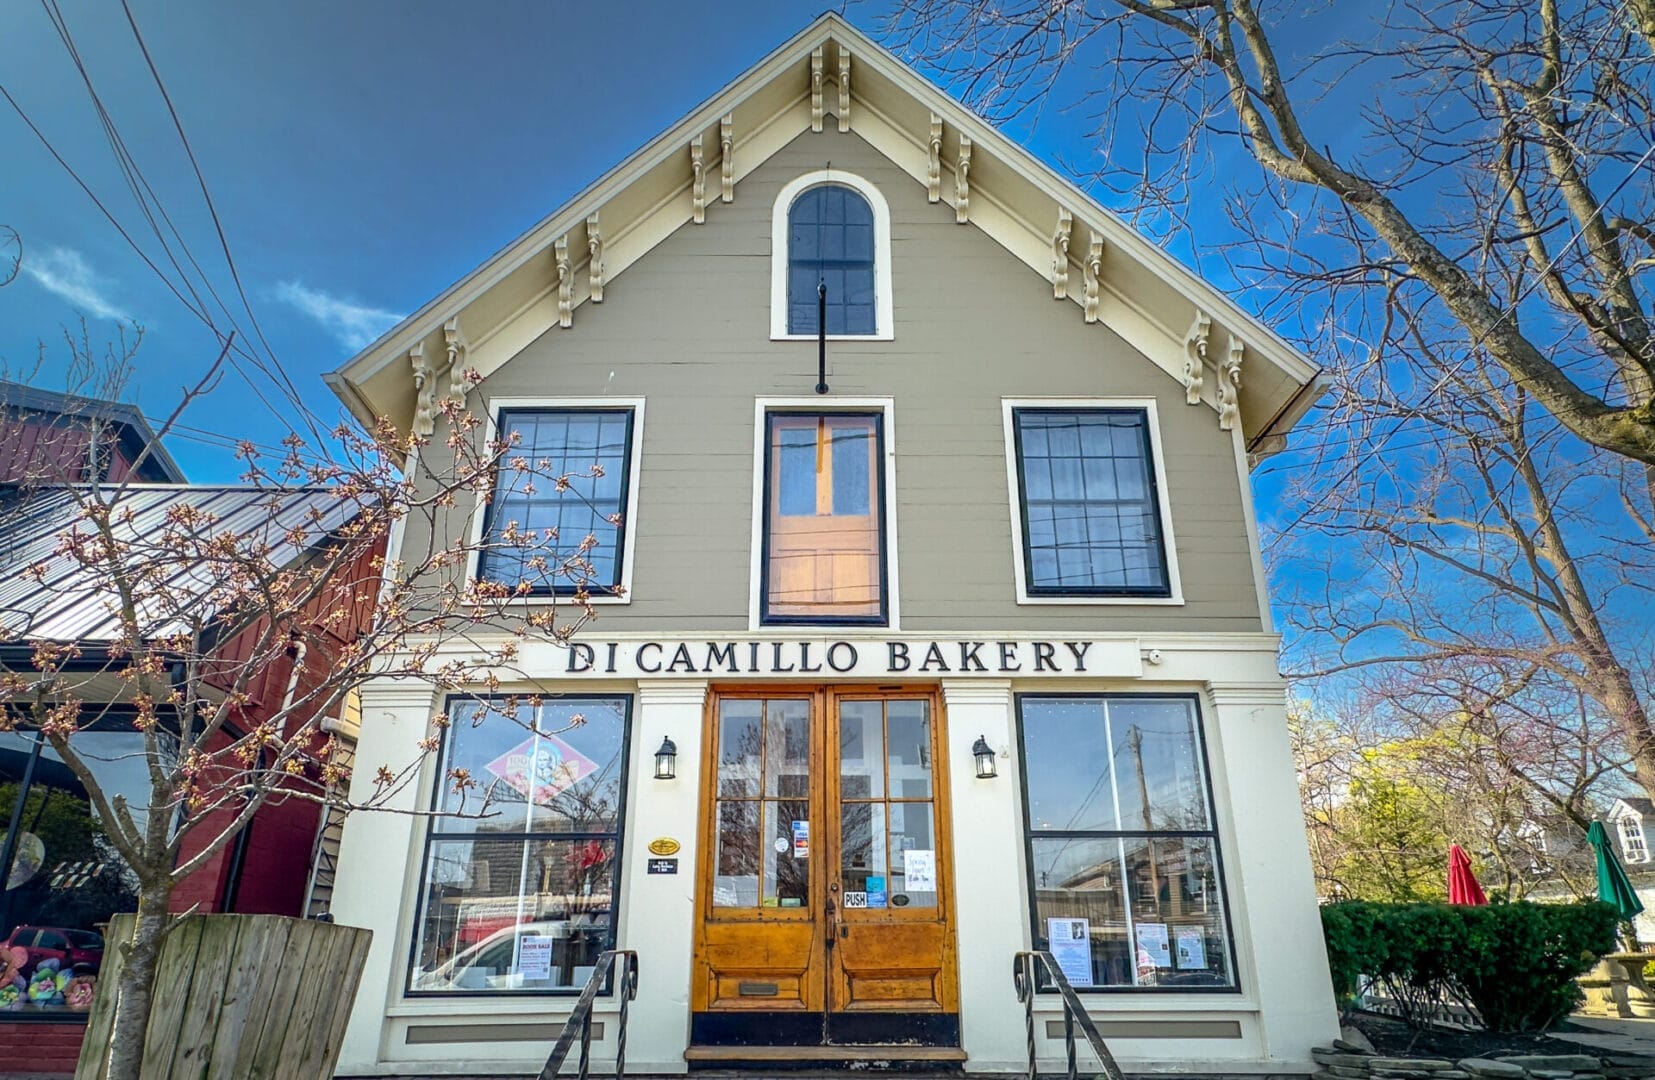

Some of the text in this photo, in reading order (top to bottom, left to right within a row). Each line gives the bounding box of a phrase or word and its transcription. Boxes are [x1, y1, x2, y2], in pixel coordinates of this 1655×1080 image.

[565, 641, 1093, 673] DI CAMILLO BAKERY
[845, 893, 866, 906] PUSH
